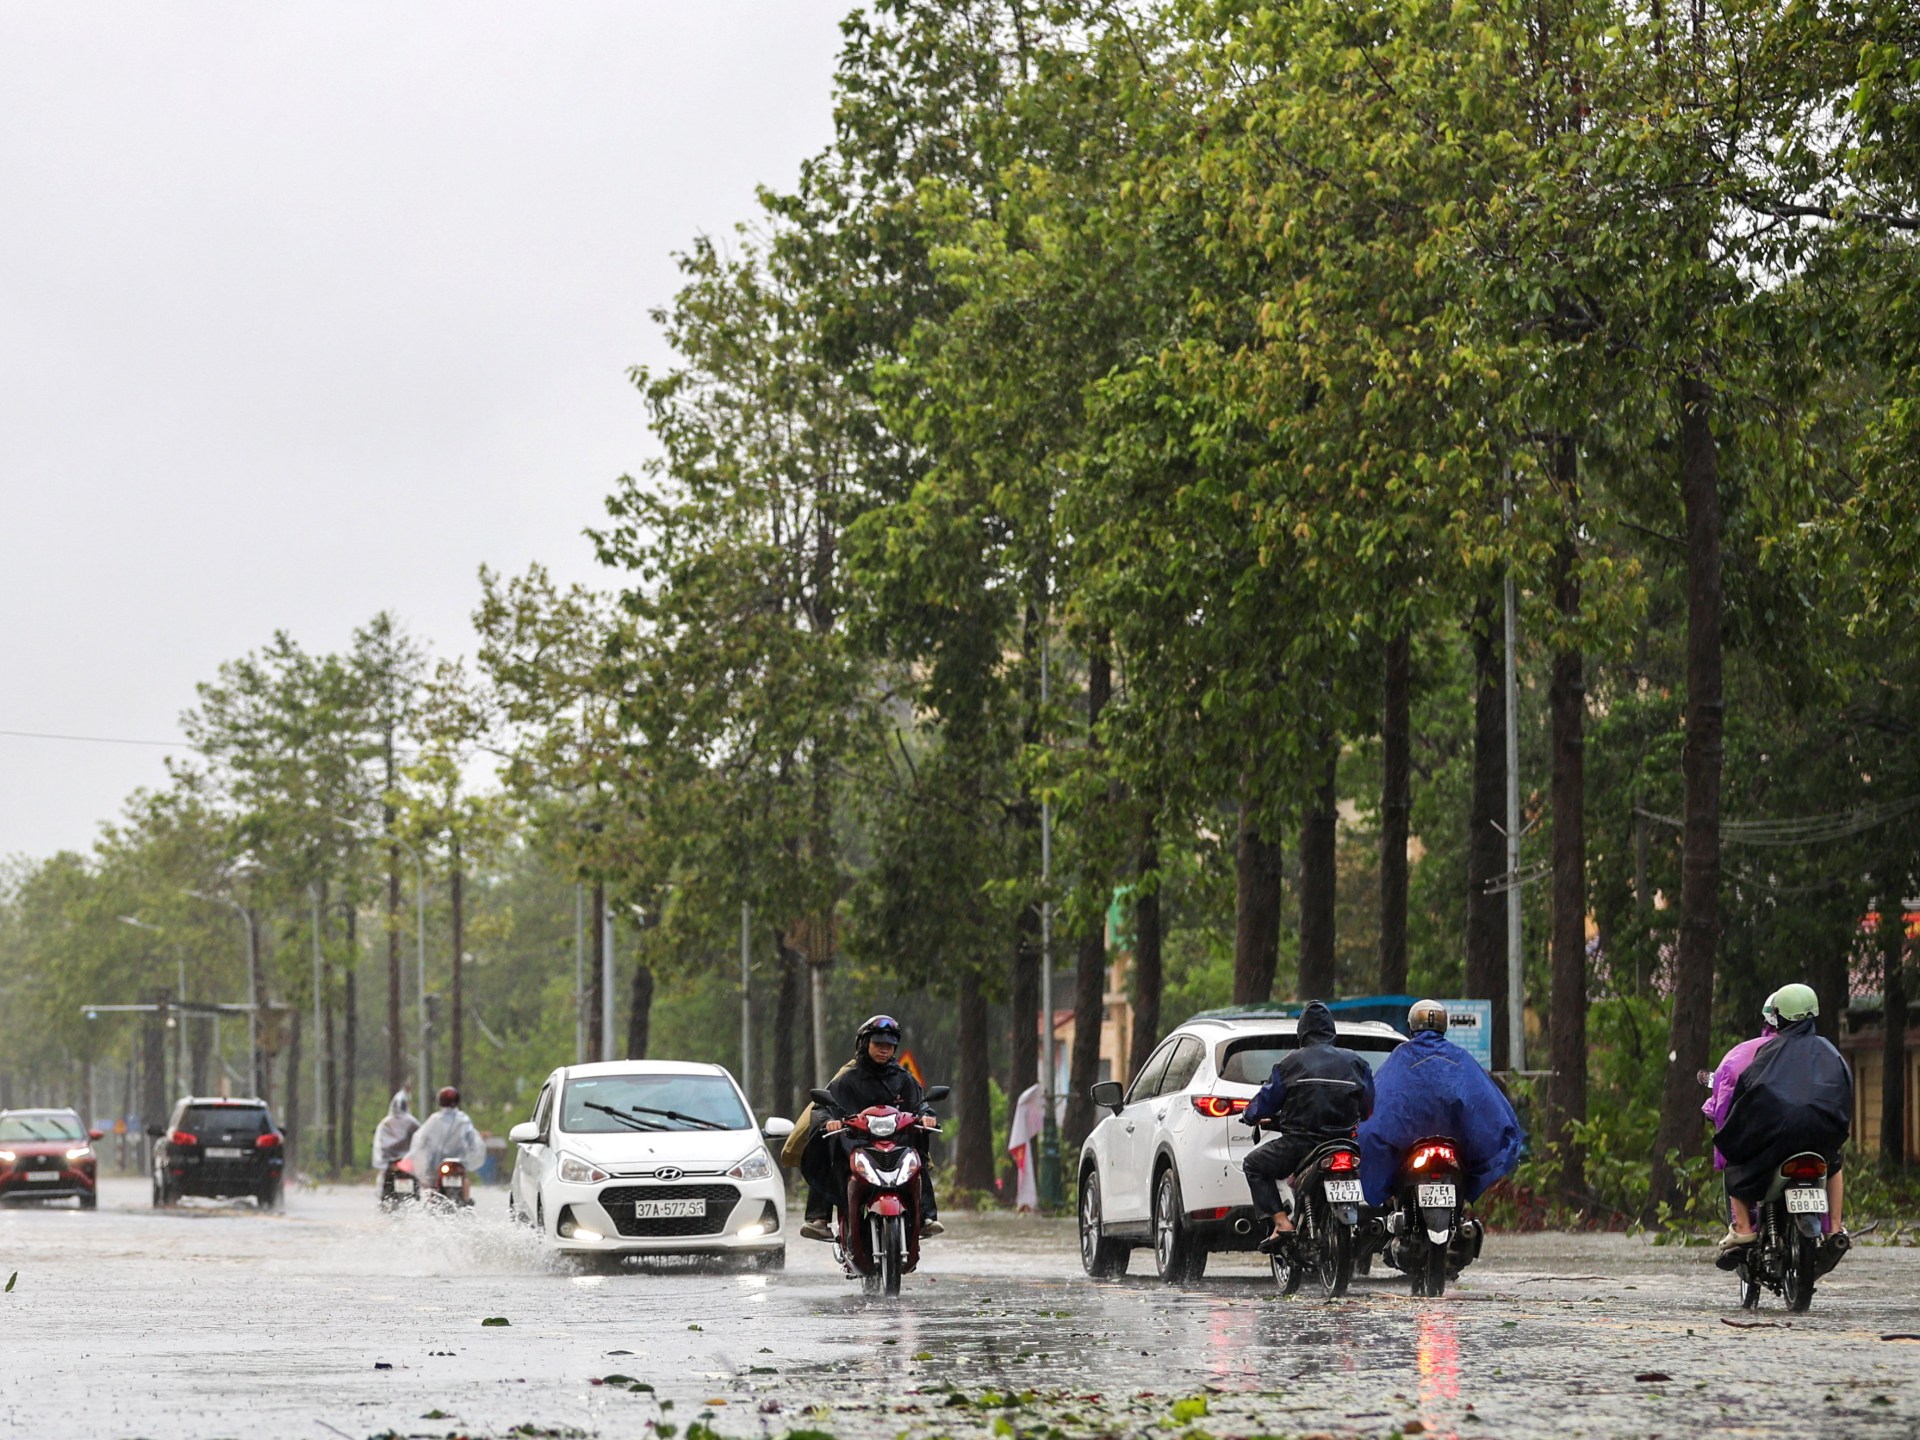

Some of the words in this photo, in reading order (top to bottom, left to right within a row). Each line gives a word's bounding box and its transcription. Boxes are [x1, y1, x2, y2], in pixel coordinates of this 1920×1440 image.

[1329, 1181, 1356, 1191] 37-B3
[1329, 1191, 1360, 1201] 124.77
[1792, 1190, 1820, 1200] 37-N1
[1790, 1200, 1825, 1211] 688.05
